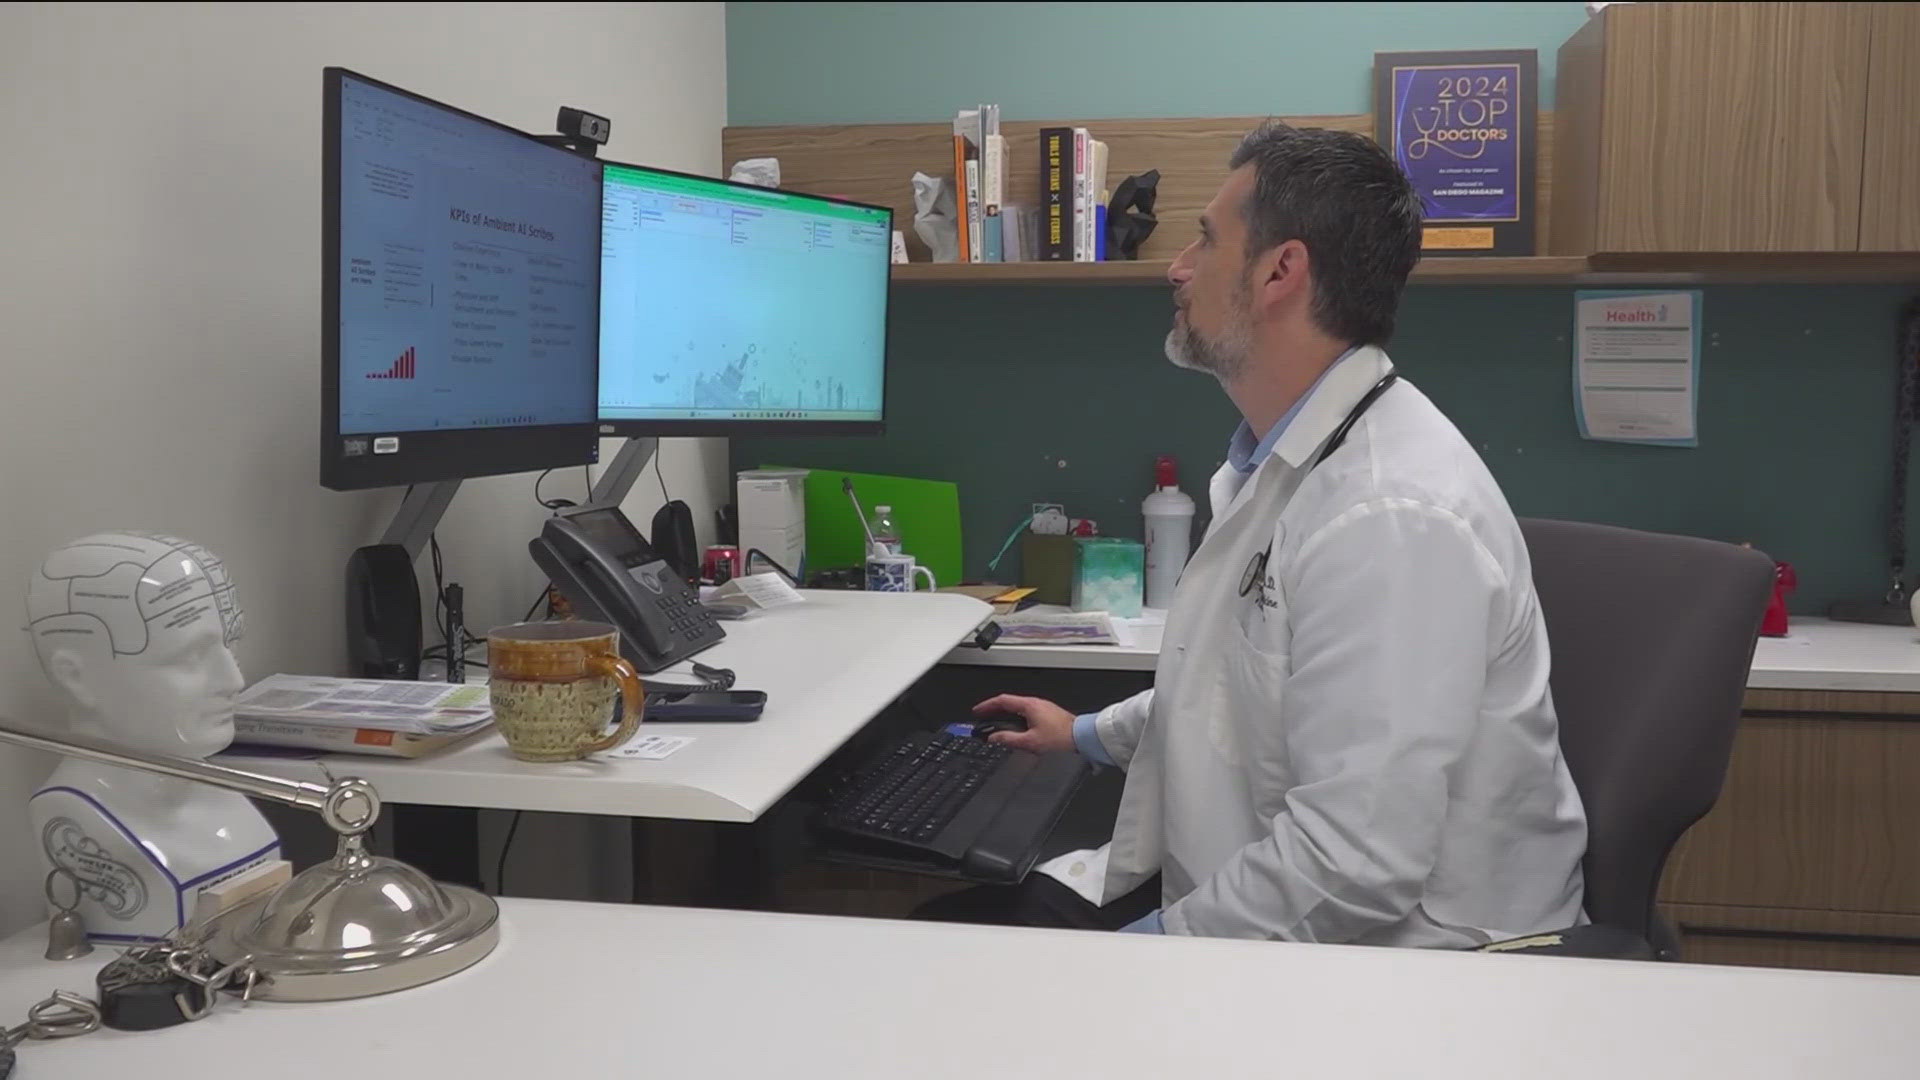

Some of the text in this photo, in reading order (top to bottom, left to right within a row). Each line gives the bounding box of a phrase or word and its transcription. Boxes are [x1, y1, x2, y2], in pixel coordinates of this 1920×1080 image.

[1438, 76, 1508, 97] 2024
[1438, 99, 1508, 126] TOP
[1050, 135, 1060, 156] TOOLS
[1437, 129, 1508, 141] DOCTORS
[1050, 168, 1060, 191] TITANS
[1050, 204, 1060, 216] TIM
[449, 207, 554, 241] KPIs of Ambient AI Scribes
[1050, 217, 1060, 245] FERRISS
[1606, 310, 1656, 322] Health
